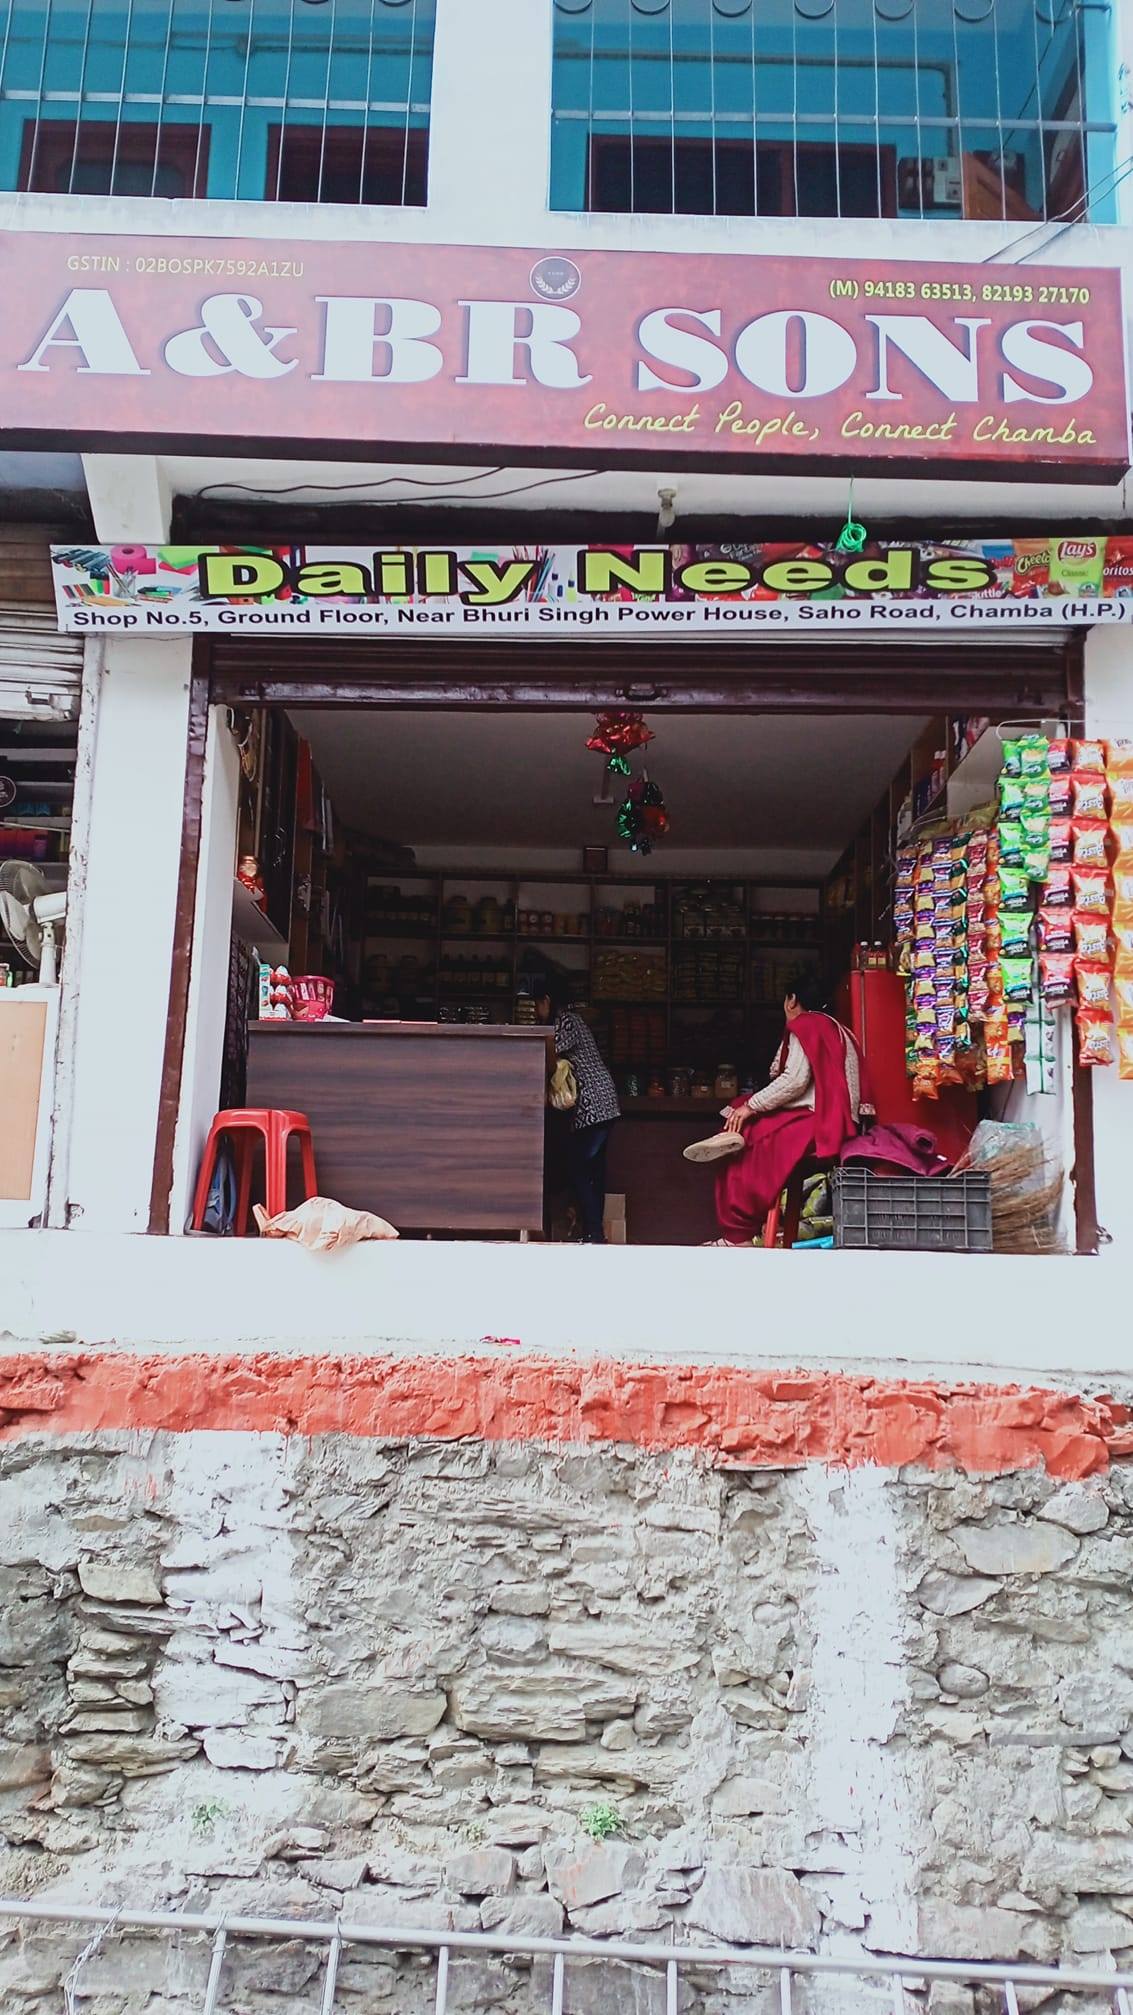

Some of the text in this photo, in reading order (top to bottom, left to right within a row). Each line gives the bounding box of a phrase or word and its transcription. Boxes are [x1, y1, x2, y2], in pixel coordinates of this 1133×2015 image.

[68, 256, 121, 272] GSTIN
[829, 280, 1090, 304] (M) 94183 63513, 82193 27170
[637, 309, 1094, 404] SONS
[584, 401, 1096, 445] Connect People, Connect Chamba
[1016, 552, 1050, 573] Cheeto
[1103, 566, 1133, 577] oritos
[198, 549, 998, 606] Daily Needs
[73, 602, 1125, 627] Shop No.5, Ground Floor, Near Bhuri Singh Power House, Saho Road, Chamba (H.P.)
